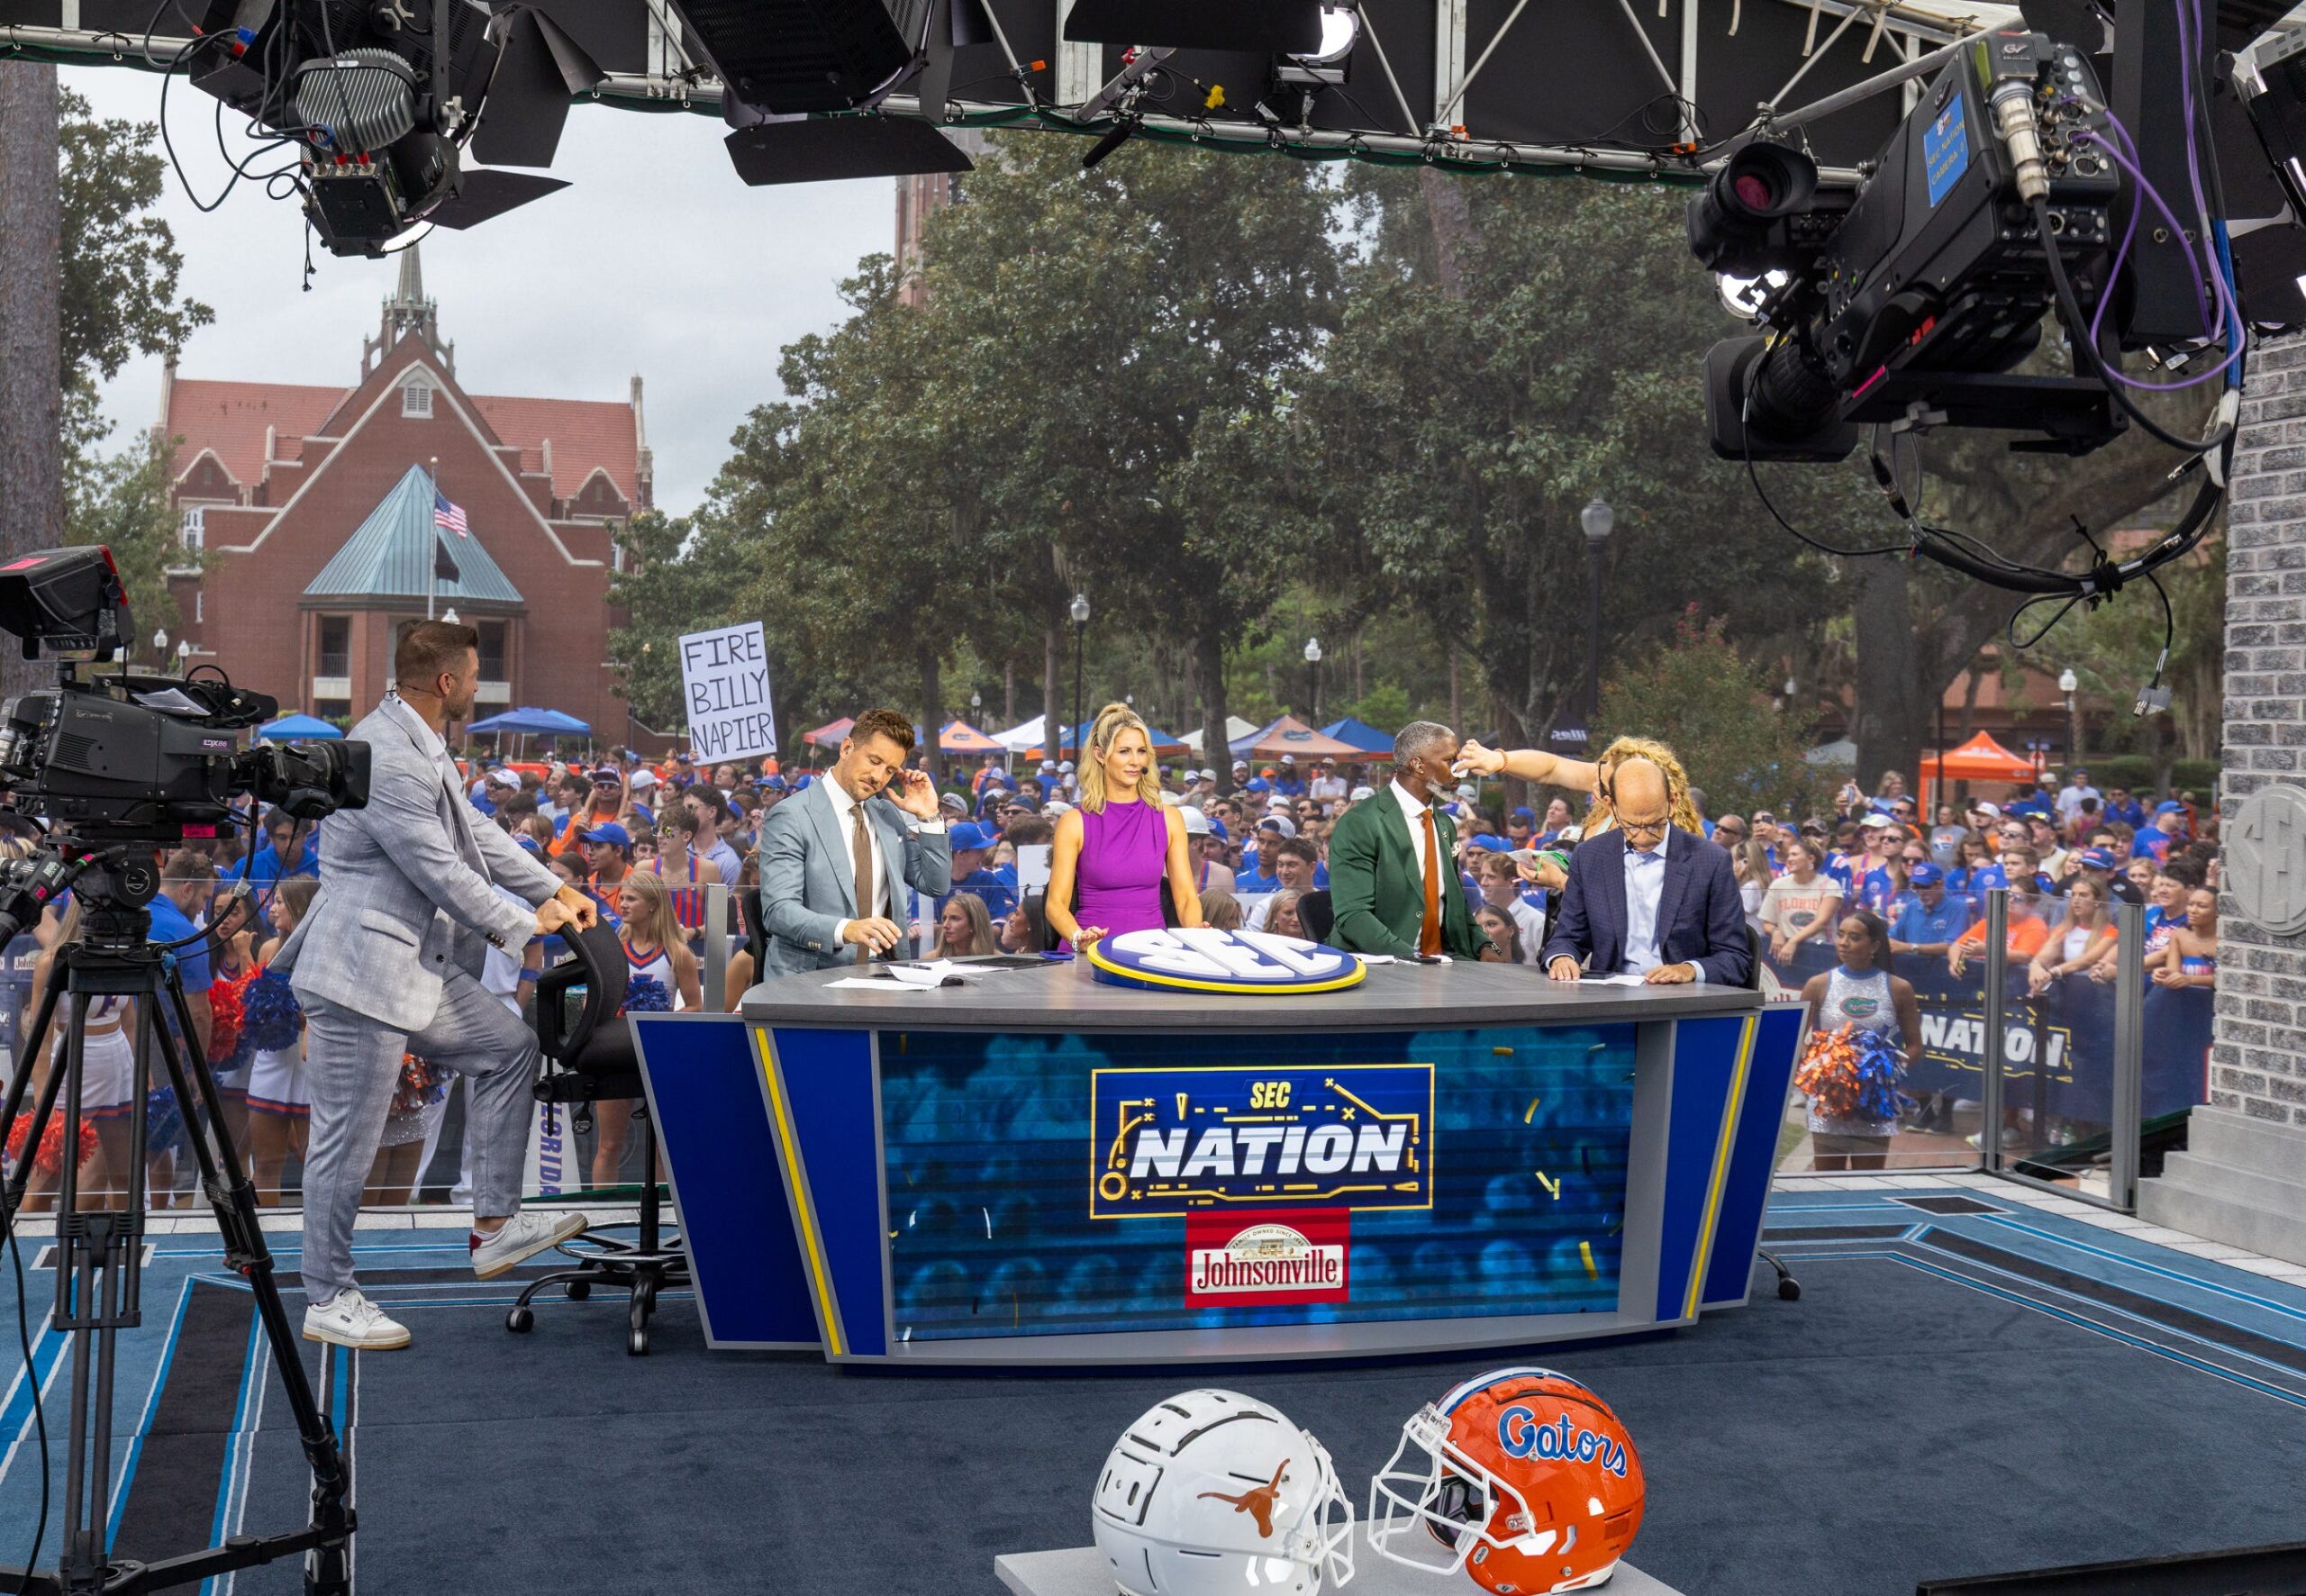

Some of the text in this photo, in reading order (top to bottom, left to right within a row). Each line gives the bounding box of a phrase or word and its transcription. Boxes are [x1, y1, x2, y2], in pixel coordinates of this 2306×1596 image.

[685, 630, 762, 672] FIRE
[691, 669, 766, 715] BILLY
[691, 712, 775, 757] NAPIER
[1778, 897, 1820, 911] FLORID
[1112, 928, 1342, 978] SEC
[1920, 1014, 2065, 1067] NATON
[1249, 1080, 1292, 1110] SEC
[540, 1101, 563, 1197] LORIDA
[1129, 1123, 1407, 1178] NATION
[1232, 1234, 1250, 1249] FAMILY
[1253, 1229, 1274, 1237] OWNED
[1276, 1229, 1292, 1238] SINCE
[1197, 1249, 1338, 1290] Johnsonville
[1497, 1405, 1628, 1478] Gators
